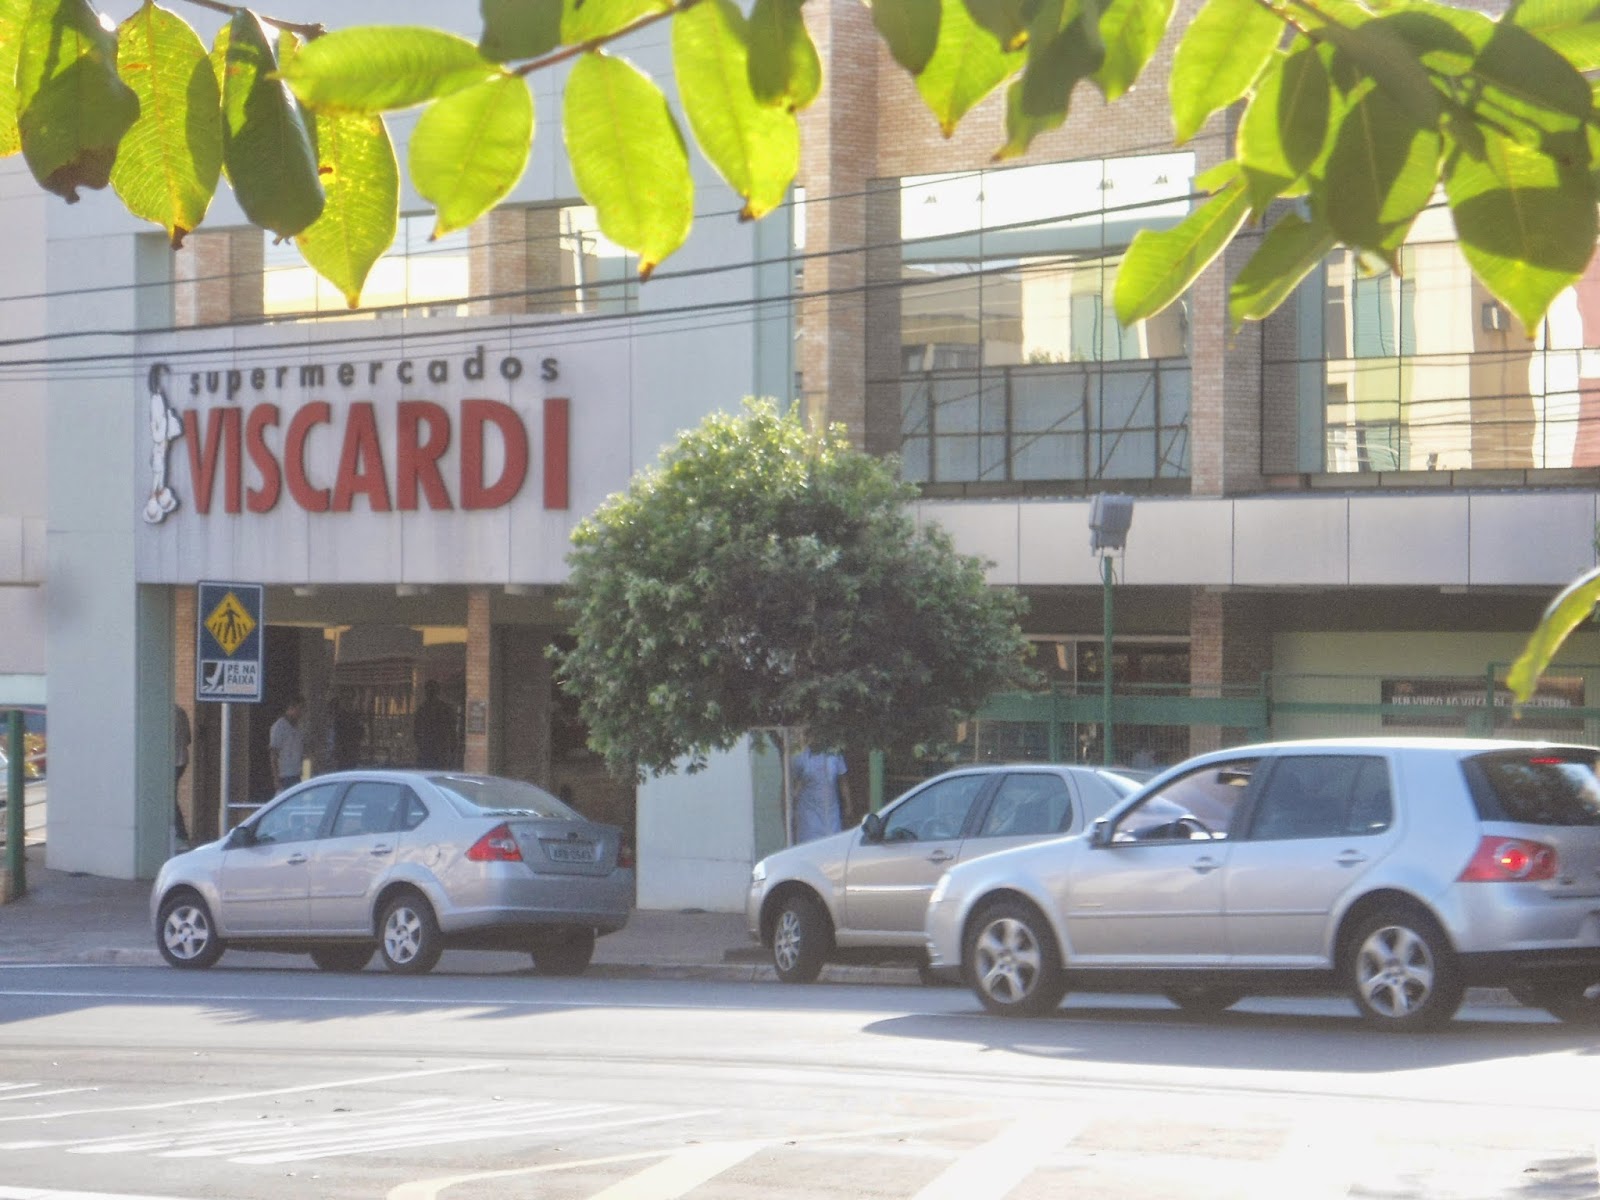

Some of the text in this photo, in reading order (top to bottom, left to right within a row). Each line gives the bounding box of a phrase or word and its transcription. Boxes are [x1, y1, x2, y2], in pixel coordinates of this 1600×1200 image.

[190, 346, 559, 397] supermercados
[183, 397, 570, 515] VISCARDI
[227, 674, 254, 685] FAIXA
[243, 664, 256, 675] NA
